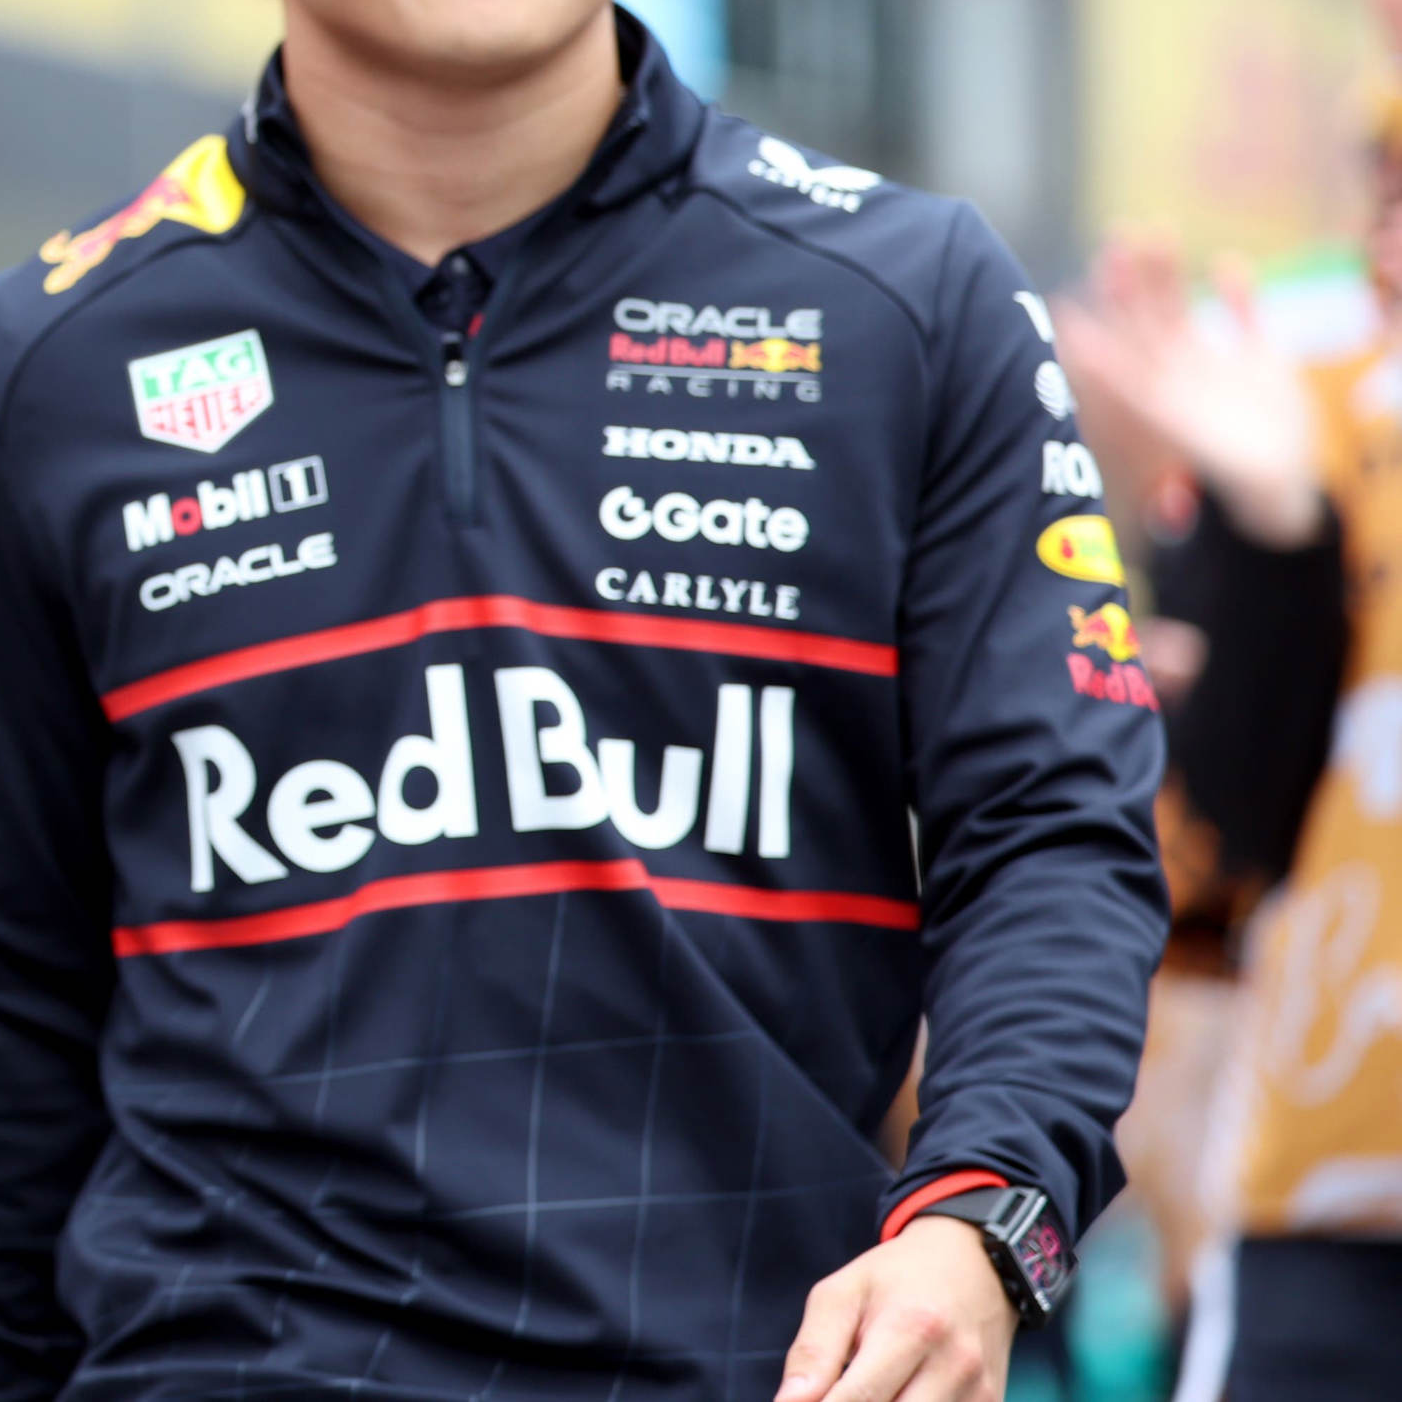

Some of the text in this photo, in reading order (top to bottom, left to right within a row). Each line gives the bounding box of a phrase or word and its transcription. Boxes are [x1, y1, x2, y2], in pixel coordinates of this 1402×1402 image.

[613, 297, 824, 340] ORACLE
[148, 344, 256, 395] TAG
[605, 370, 823, 403] RACING
[601, 425, 816, 471] HONDA
[122, 462, 310, 553] Mobil 1
[652, 491, 811, 553] Gate
[139, 531, 338, 612] ORACLE
[594, 567, 801, 621] CARLYLE
[170, 663, 796, 893] Red Bull
